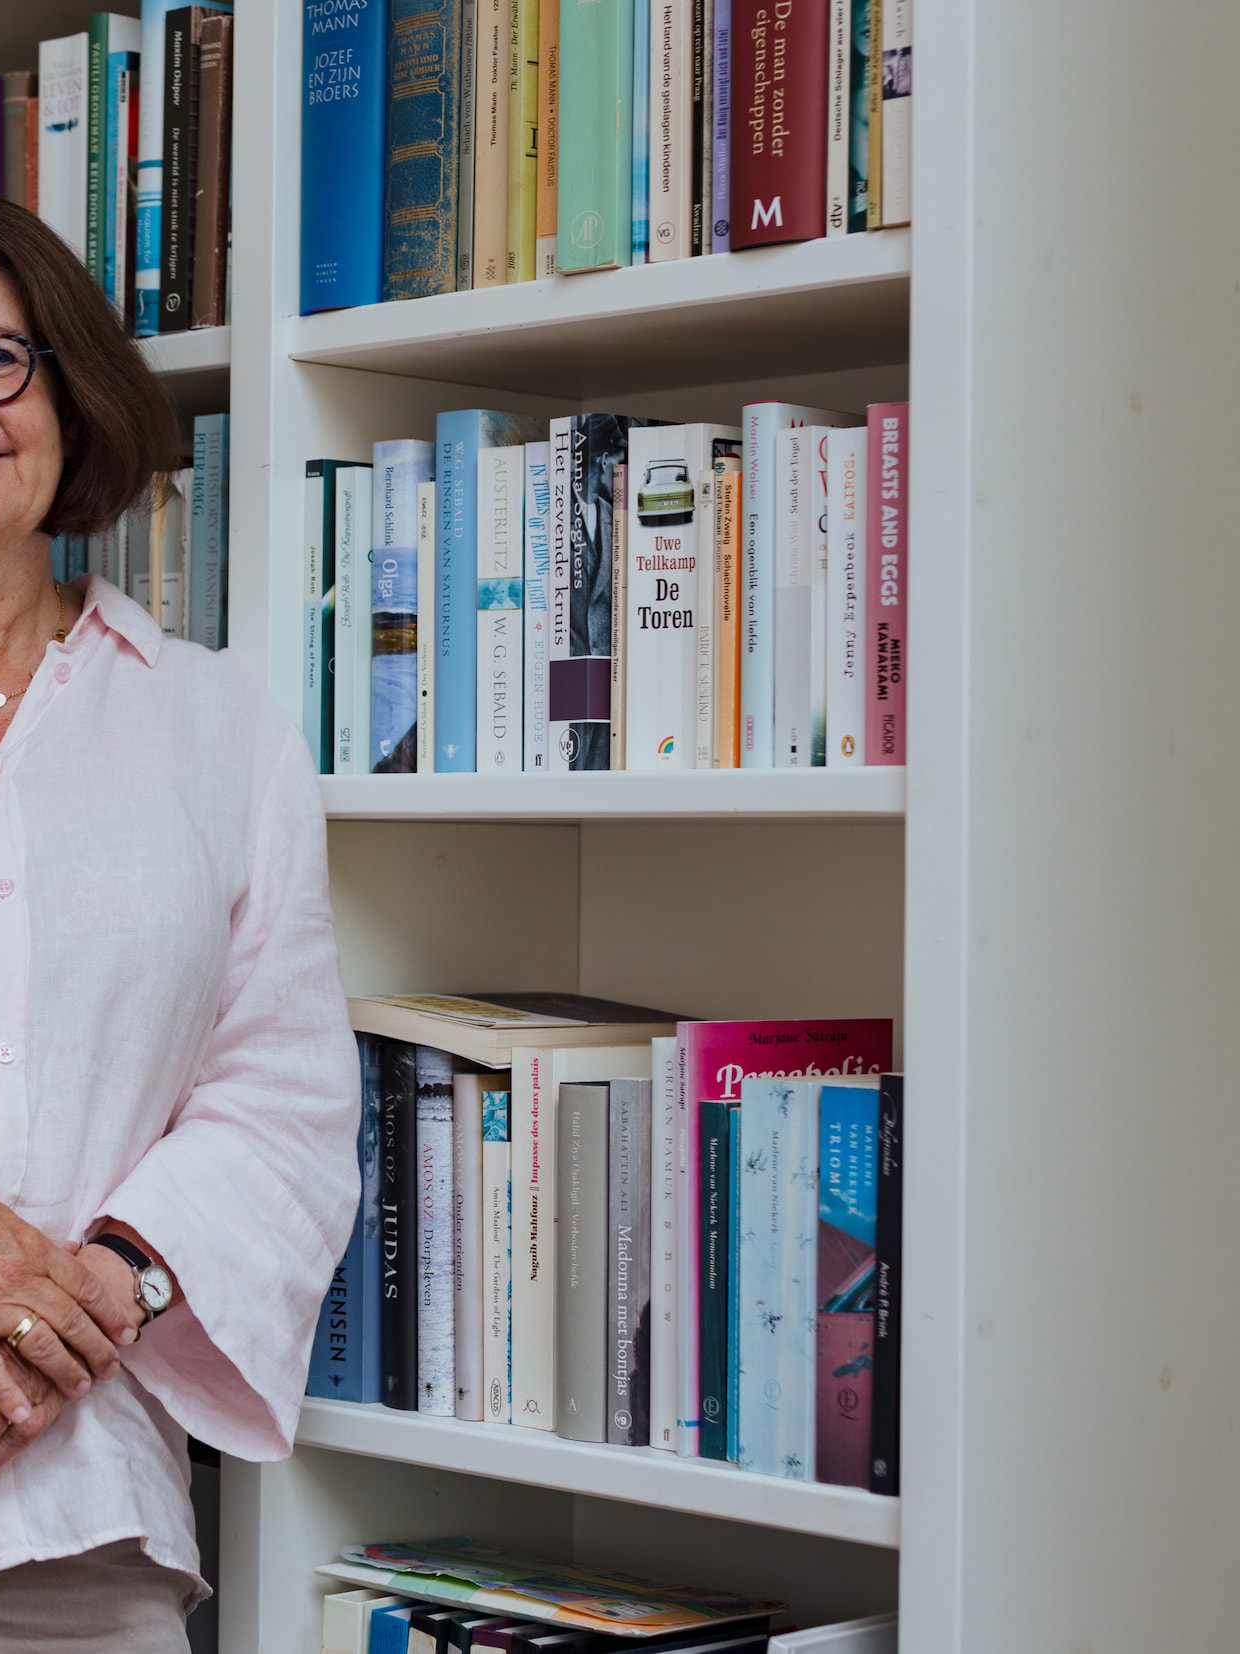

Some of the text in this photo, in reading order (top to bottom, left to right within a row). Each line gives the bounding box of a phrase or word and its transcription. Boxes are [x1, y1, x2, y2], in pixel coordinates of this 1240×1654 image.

[307, 0, 368, 19] THOMAS
[312, 13, 358, 36] MANN
[42, 80, 82, 99] LEVEN
[309, 66, 361, 88] EN ZIJN
[309, 83, 359, 106] BROERS
[314, 48, 353, 70] JOZEF
[749, 8, 771, 155] eigenschappen
[771, 0, 792, 157] De man zonder
[57, 95, 80, 114] LOT
[546, 45, 557, 187] THOMAS MANN DOCTOR FAUSTUS
[661, 5, 672, 193] Het land van de geslagen kinderen
[168, 30, 183, 279] Maxim Osipov De wereld is niet stuk te krijgen
[143, 208, 152, 264] requiem for
[751, 195, 783, 231] M
[830, 203, 842, 228] dtv
[194, 433, 206, 472] PETER
[454, 441, 465, 539] W.G. SEBALD
[384, 466, 394, 546] Bernhard Schlink
[494, 457, 508, 572] AUSTERLITZ
[526, 463, 551, 612] IN TIMES OF FADING LIGHT
[554, 432, 569, 647] Het zevende kruis
[570, 430, 588, 590] Anna Seghers
[613, 518, 621, 543] Joseph
[654, 536, 681, 551] Uwe
[747, 416, 759, 654] Martin Walser Een ogenblik van liefde
[789, 436, 800, 585] Christa Wolf Stadt der Engel
[881, 416, 899, 607] BREASTS AND EGGS
[379, 558, 399, 599] Olga
[441, 443, 452, 658] DE RINGEN VAN SATURNUS
[636, 555, 696, 573] Tellkamp
[655, 578, 680, 601] De
[723, 484, 733, 622] Stefan Zweig Schachnovelle
[844, 452, 856, 679] Jenny Erpenbeck KAIROS.
[612, 582, 620, 612] Legende
[637, 607, 694, 630] Toren
[493, 617, 507, 740] W. G. SEBALD
[612, 629, 620, 657] heiligen
[877, 622, 889, 701] KAWAKAMI
[890, 638, 901, 684] MIEKO
[534, 640, 545, 743] EUGEN RUGE
[340, 727, 351, 743] 125
[883, 714, 895, 755] PICADOR
[748, 1028, 849, 1048] Marjane Satrapi
[664, 1059, 674, 1126] ORHAN
[382, 1090, 398, 1300] AMOS OZ JUDAS
[529, 1057, 541, 1282] Naguib Mahfouz Impasse des deux palais
[621, 1100, 629, 1212] SABAHATTIN ALI
[664, 1137, 674, 1200] PAMUK
[829, 1122, 841, 1196] TRIOMF
[847, 1123, 858, 1215] VAN NIEKERK
[864, 1124, 873, 1188] MARLENE
[421, 1143, 435, 1307] AMOS OZ Dorpsleven
[455, 1121, 465, 1292] AMOS OZ Onder vrienden
[709, 1137, 718, 1290] Marlene van Niekerk Memorandum
[491, 1186, 501, 1338] Amin Maalouf The Gardens of Light
[879, 1261, 890, 1297] André
[330, 1266, 347, 1362] MENSEN
[612, 1223, 633, 1396] Madonna met bontjas
[878, 1309, 890, 1339] Brink
